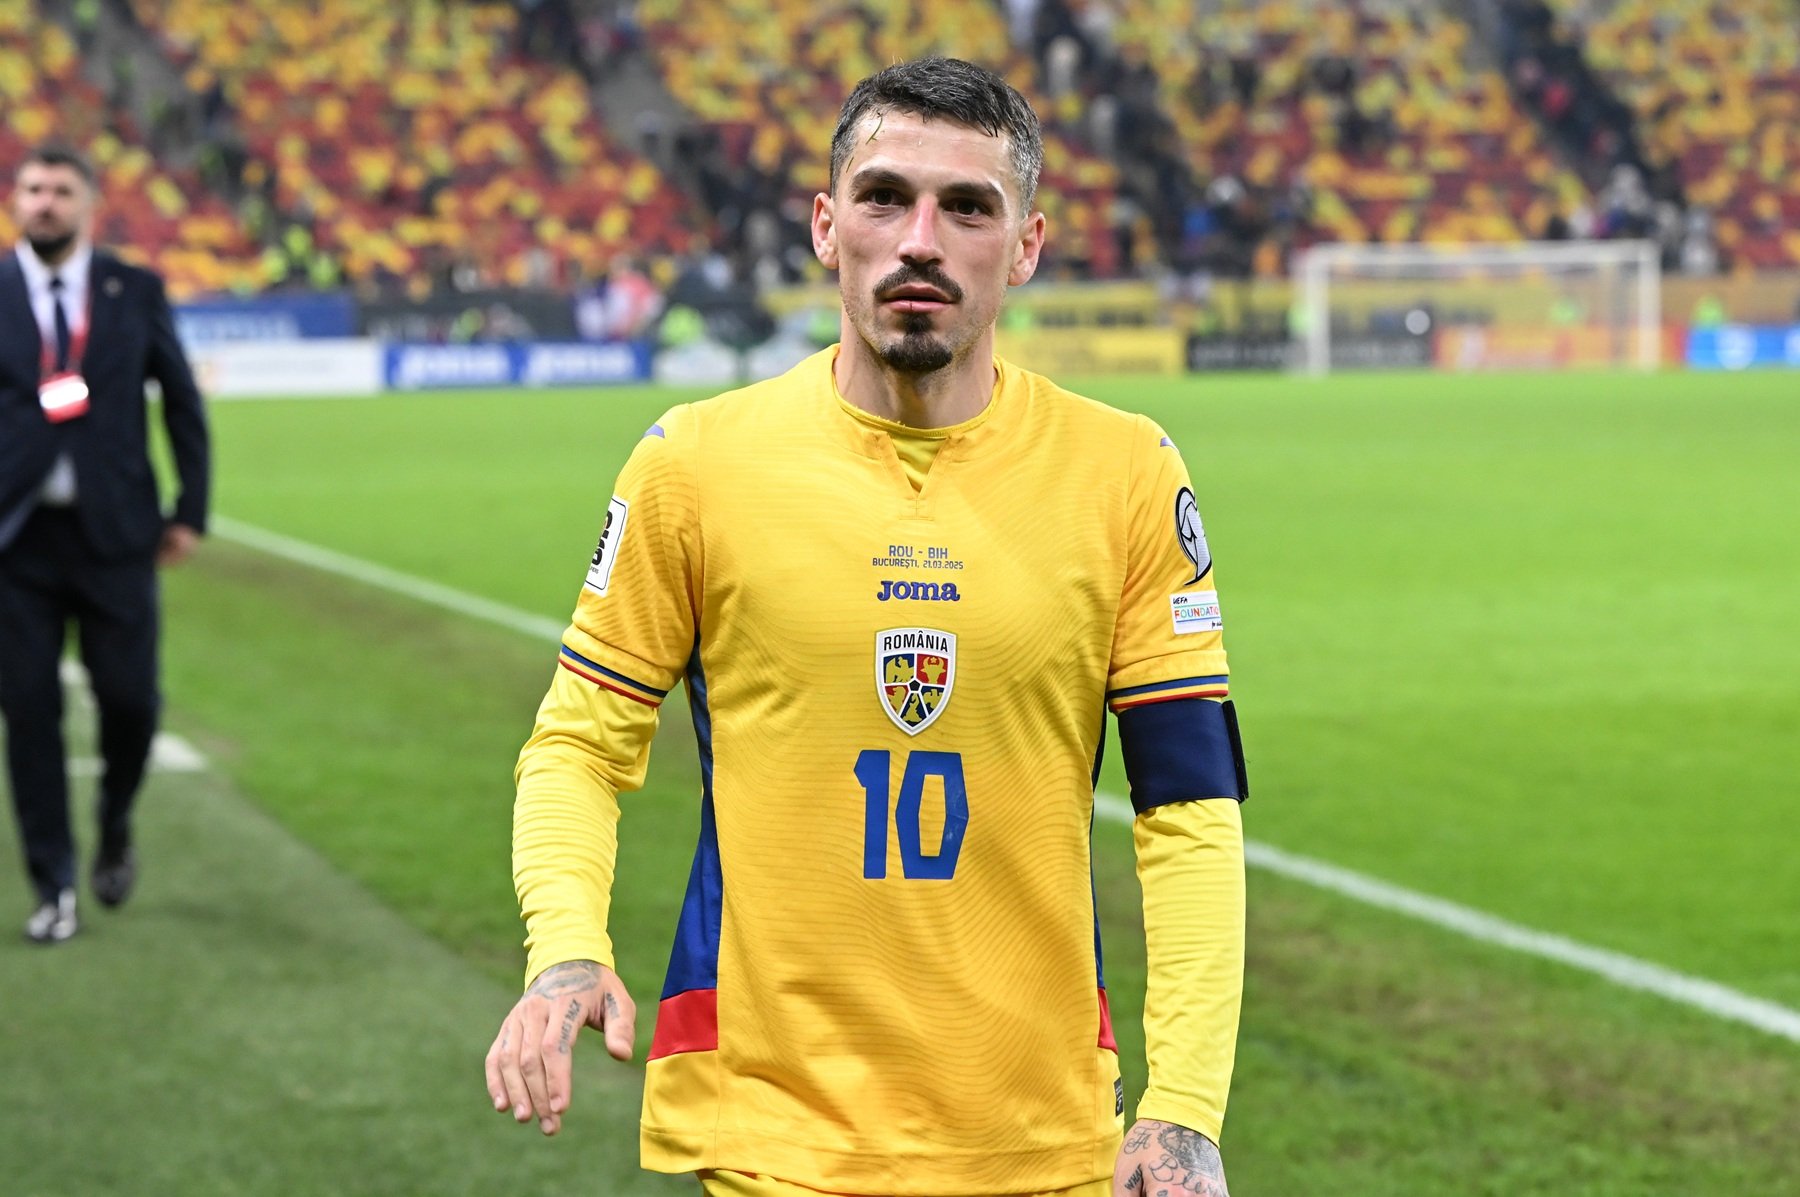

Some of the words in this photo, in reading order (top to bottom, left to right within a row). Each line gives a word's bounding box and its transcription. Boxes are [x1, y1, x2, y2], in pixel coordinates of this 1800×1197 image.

[889, 545, 913, 558] ROU
[928, 547, 948, 559] BIH
[923, 560, 964, 570] 21.03.2025
[1174, 607, 1218, 619] FOUNDATIO
[883, 630, 949, 653] ROMÂNIA
[854, 749, 970, 880] 10
